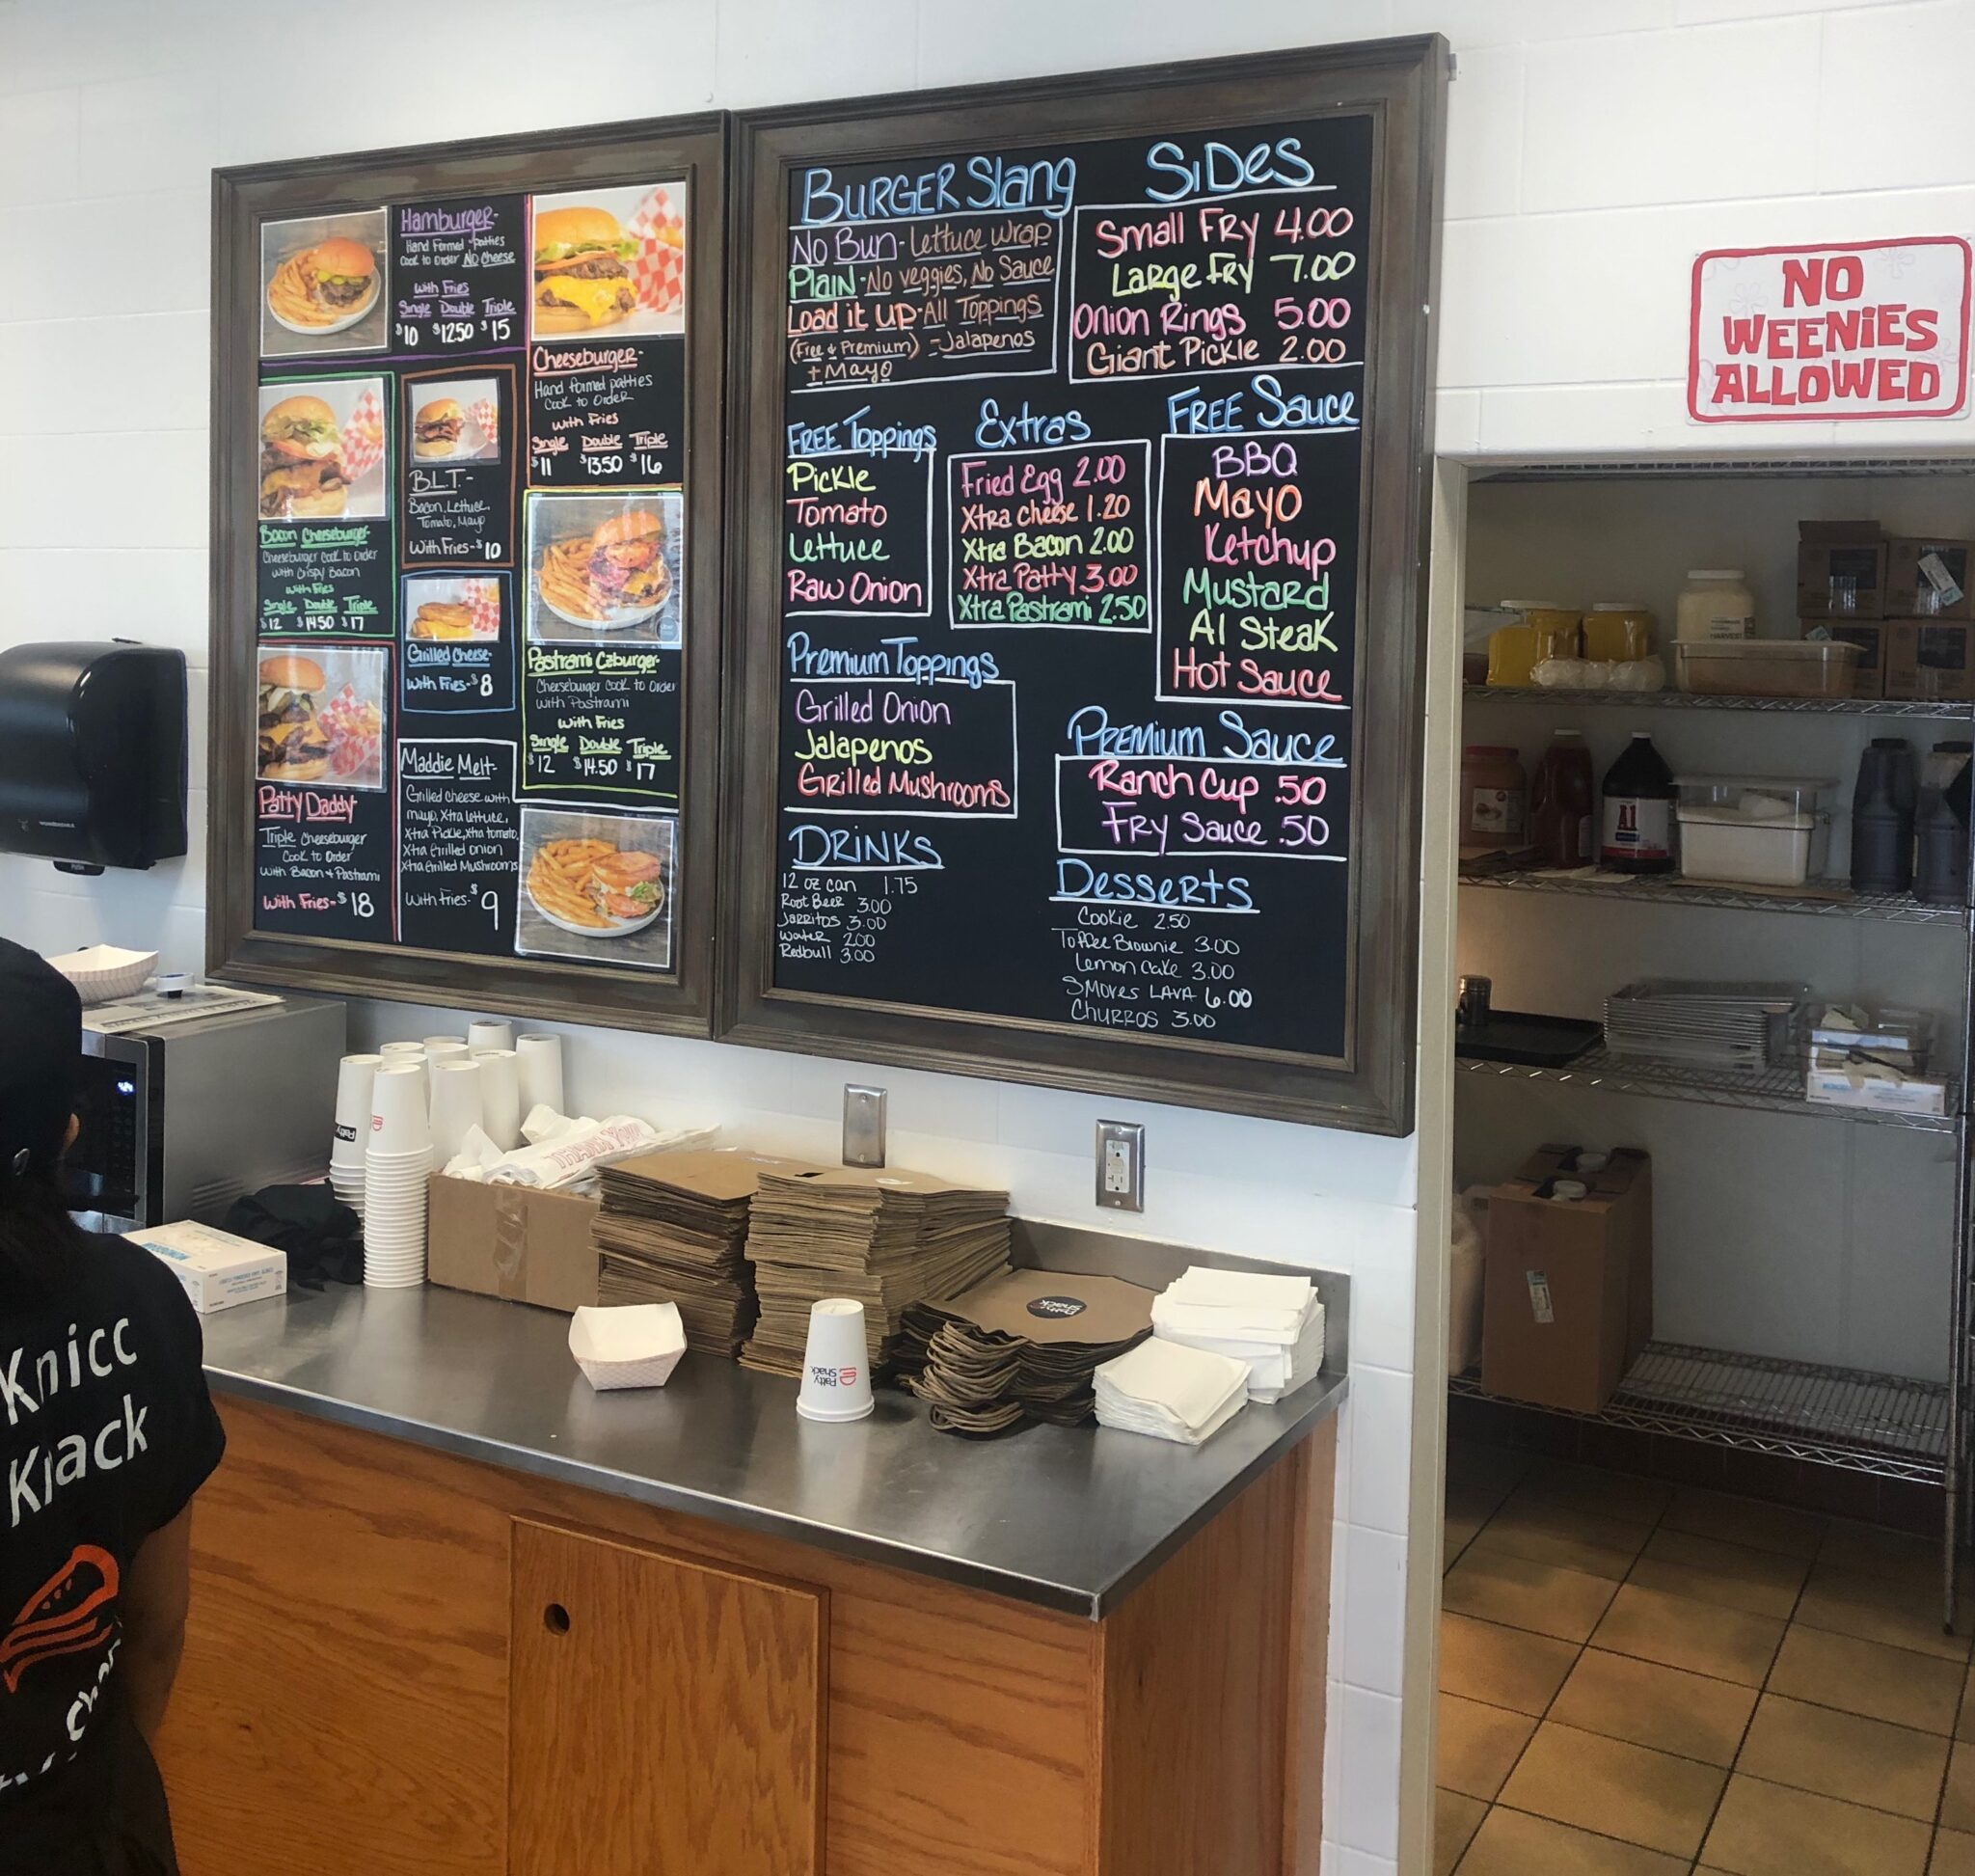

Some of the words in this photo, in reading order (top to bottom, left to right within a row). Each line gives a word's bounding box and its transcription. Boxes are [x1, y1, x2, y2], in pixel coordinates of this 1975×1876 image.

[801, 163, 960, 225] BURGER
[966, 156, 1076, 218] Slang
[792, 231, 826, 264] No
[1096, 211, 1183, 258] Small
[1274, 207, 1353, 243] 4.00
[970, 259, 993, 284] No
[999, 256, 1054, 282] Sauce
[1269, 251, 1356, 283] 7.00
[1782, 257, 1863, 308] NO
[442, 280, 469, 294] Fries
[788, 303, 838, 334] Load
[846, 303, 869, 328] it
[955, 294, 1042, 325] Toppings
[1073, 303, 1150, 340] Onion
[1160, 302, 1246, 340] Rings
[1274, 297, 1351, 330] 5.00
[1087, 341, 1176, 375] Giant
[1179, 337, 1259, 367] Pickle
[1280, 335, 1346, 362] 2.00
[534, 381, 564, 399] Hand
[1711, 358, 1940, 406] ALLOWED
[552, 417, 583, 431] with
[588, 413, 618, 425] Fries
[1168, 386, 1244, 434] FREE
[1251, 375, 1360, 427] Sauce
[788, 422, 841, 454] FREE
[843, 405, 936, 463] Toppings
[976, 397, 1091, 449] Extras
[787, 461, 877, 493] Pickle
[1212, 441, 1298, 478] BBQ
[961, 461, 1015, 498] Fried
[1020, 464, 1064, 504] Egg
[1072, 454, 1125, 487] 2.00
[787, 497, 887, 528] Tomato
[1087, 493, 1130, 523] 1.20
[1194, 476, 1302, 530] Mayo
[789, 531, 890, 561] Lettuce
[962, 537, 1007, 563] Xtra
[1015, 532, 1082, 559] Bacon
[1090, 526, 1134, 555] 2.00
[1205, 523, 1337, 581] Ketchup
[329, 567, 361, 578] Bacon
[787, 569, 845, 602] Raw
[850, 571, 921, 607] Onion
[962, 566, 1012, 591] Xtra
[1014, 561, 1076, 595] Patty
[1079, 563, 1138, 593] 3.00
[957, 594, 1007, 622] Xtra
[1007, 590, 1092, 622] Pastrami
[1097, 594, 1147, 625] 2.50
[407, 643, 450, 663] Grilled
[528, 647, 592, 672] Pastrami
[787, 631, 888, 675] Premium
[880, 637, 999, 689] Toppings
[1174, 648, 1231, 690] Hot
[1236, 659, 1342, 701] Sauce
[796, 689, 872, 722] Grilled
[883, 692, 951, 724] Onion
[795, 729, 933, 766] Jalapenos
[1219, 710, 1343, 762] Sauce
[400, 748, 454, 774] Maddie
[259, 785, 302, 823] Patty
[888, 771, 1011, 807] Mushrooms
[1088, 759, 1194, 800] Ranch
[1200, 768, 1259, 814] Cup
[1274, 775, 1326, 805] .50
[1180, 812, 1268, 846] Sauce
[1279, 815, 1330, 847] .50
[311, 852, 322, 861] to
[783, 873, 798, 889] 12
[804, 878, 821, 890] oz
[826, 879, 856, 892] can
[884, 876, 918, 895] 1.75
[781, 893, 809, 909] Root
[857, 898, 892, 914] 3.00
[1078, 906, 1139, 928] Cookie
[1154, 913, 1190, 930] 2.50
[847, 915, 886, 931] 3.00
[840, 948, 875, 964] 3.00
[1113, 934, 1183, 954] Brownie
[1195, 937, 1240, 954] 3.00
[1192, 963, 1234, 980] 3.00
[1205, 988, 1252, 1008] 6.00
[1172, 1011, 1216, 1028] 3.00
[0, 1318, 137, 1426] Knicc
[814, 1377, 837, 1387] Patty
